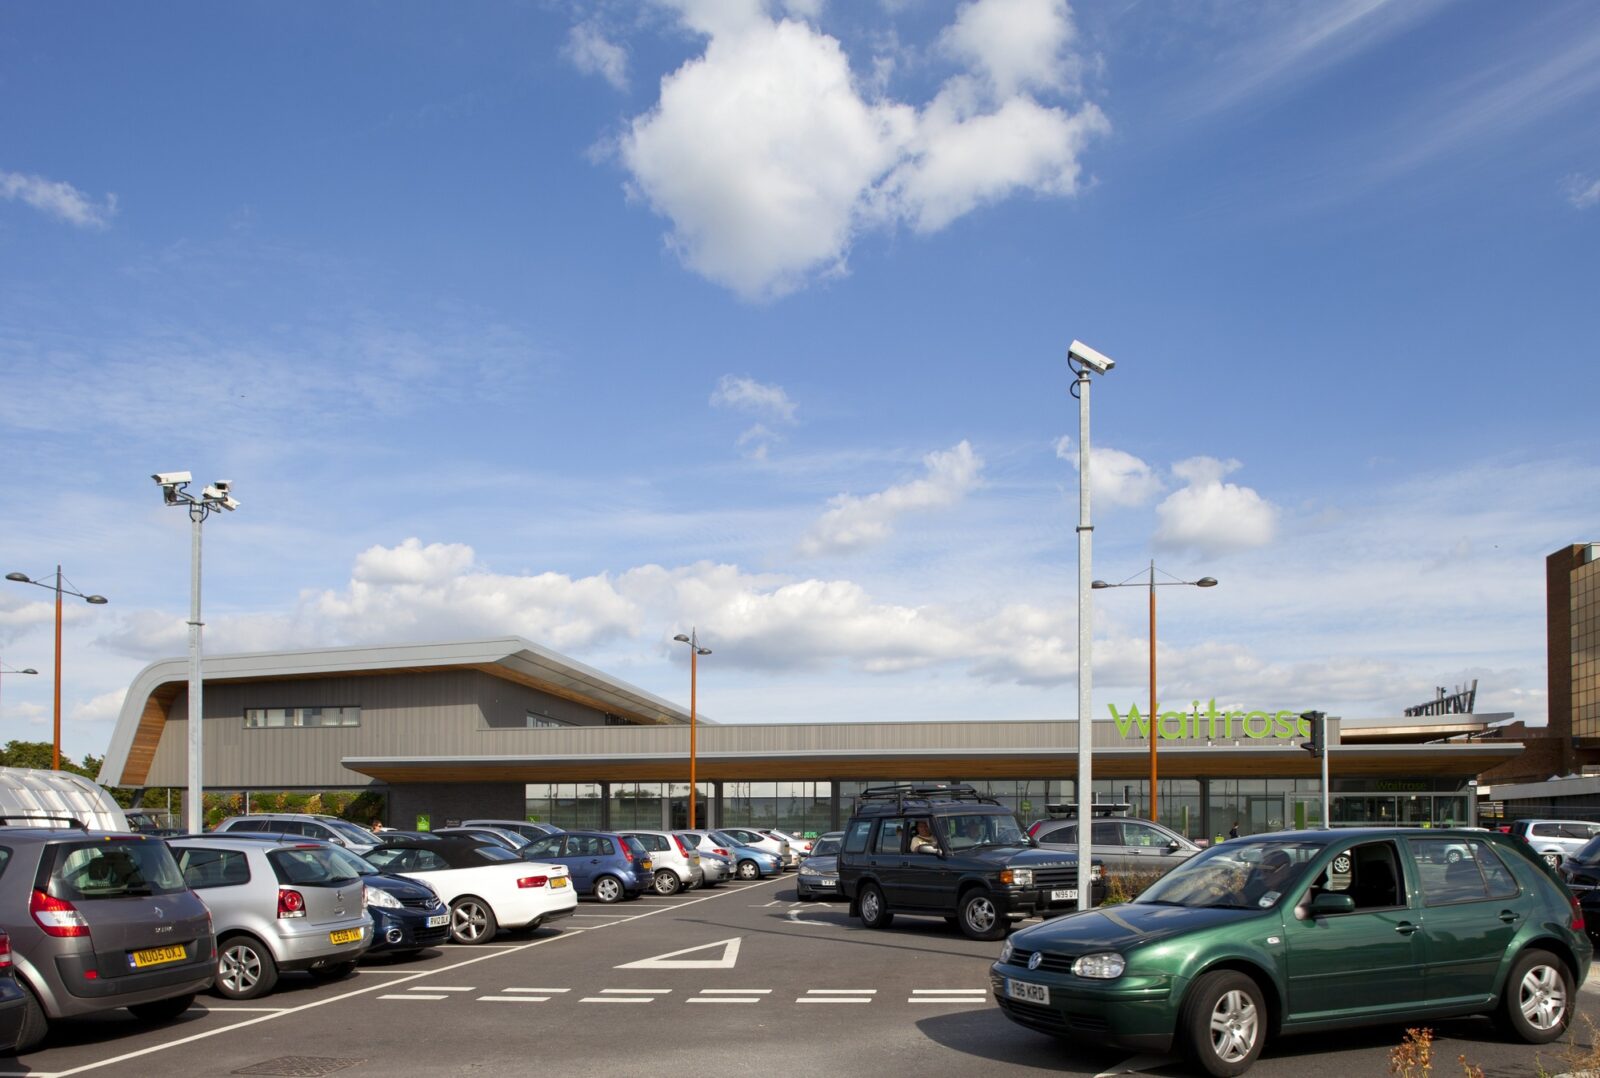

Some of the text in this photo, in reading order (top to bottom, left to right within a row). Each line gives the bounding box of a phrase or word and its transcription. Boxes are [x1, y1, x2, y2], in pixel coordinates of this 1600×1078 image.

[1376, 781, 1426, 791] Waitrose
[137, 946, 182, 964] NU05 OXJ
[1026, 984, 1045, 1001] KRD
